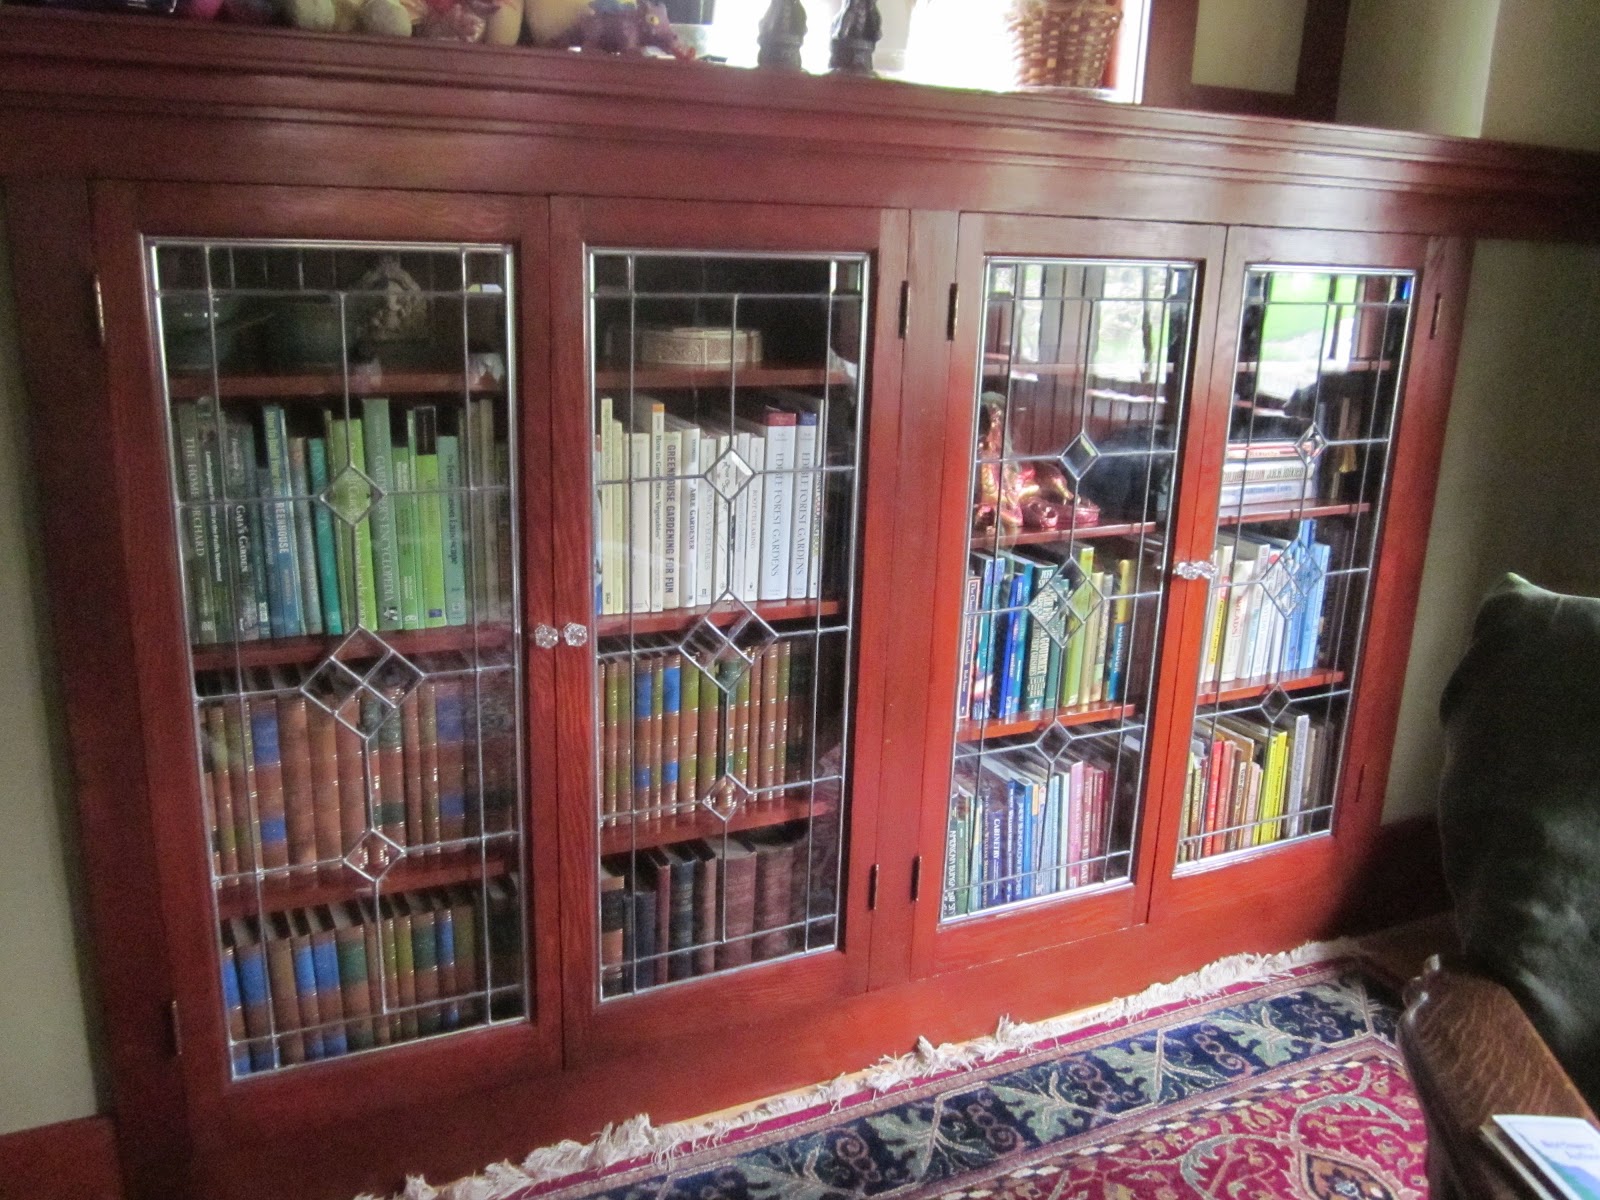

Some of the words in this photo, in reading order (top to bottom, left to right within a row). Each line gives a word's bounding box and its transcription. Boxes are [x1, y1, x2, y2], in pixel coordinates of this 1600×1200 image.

[185, 437, 197, 461] THE
[655, 435, 663, 451] How
[188, 463, 201, 498] HOME
[801, 453, 811, 485] EDBLE
[376, 456, 390, 521] GARDER'S
[690, 487, 698, 507] ABLE
[798, 488, 809, 525] FOREST
[773, 490, 783, 526] FOREST
[274, 501, 290, 554] REENHOUSE
[665, 505, 676, 554] GARDENING
[688, 509, 697, 550] GARDENER
[703, 520, 713, 570] VEGETABLES
[750, 510, 758, 549] CELLARING
[238, 536, 249, 573] GARDEN
[381, 524, 395, 602] ENCYCLOPEDIA
[665, 557, 675, 574] FOR
[770, 528, 782, 577] GARDENS
[795, 527, 807, 576] GARDENS
[665, 576, 675, 593] FUN
[1037, 637, 1051, 675] GOURMET
[948, 830, 957, 865] AMERICAN
[992, 818, 1002, 860] CABINETRY
[1016, 823, 1024, 864] BUNGALOW
[947, 866, 957, 902] BUNGAOW
